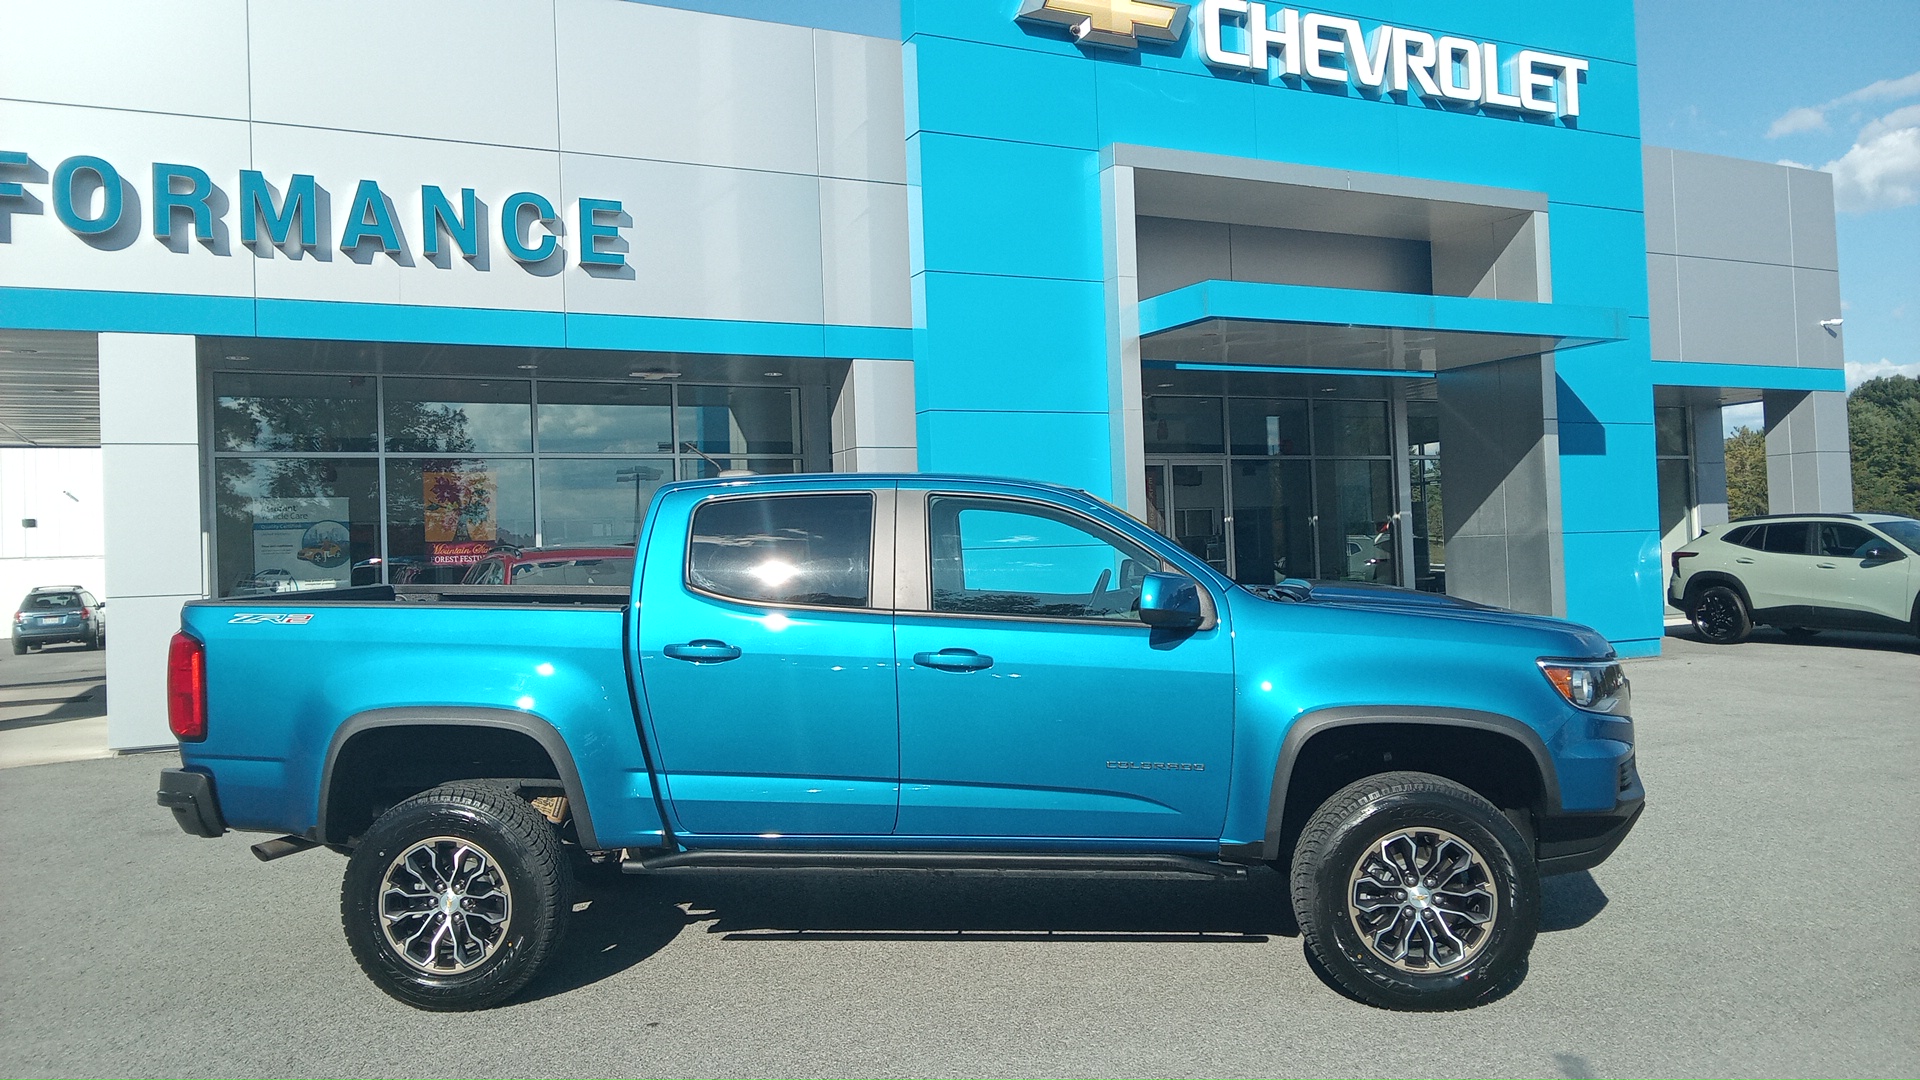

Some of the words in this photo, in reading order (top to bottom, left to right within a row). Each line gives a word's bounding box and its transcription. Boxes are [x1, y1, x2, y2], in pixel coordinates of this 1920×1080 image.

[1204, 0, 1589, 118] CHEVROLET
[290, 512, 308, 520] Care
[433, 543, 470, 555] Mountain
[431, 554, 459, 563] FOREST
[227, 613, 315, 625] ZR2
[1106, 760, 1205, 771] COLORADO
